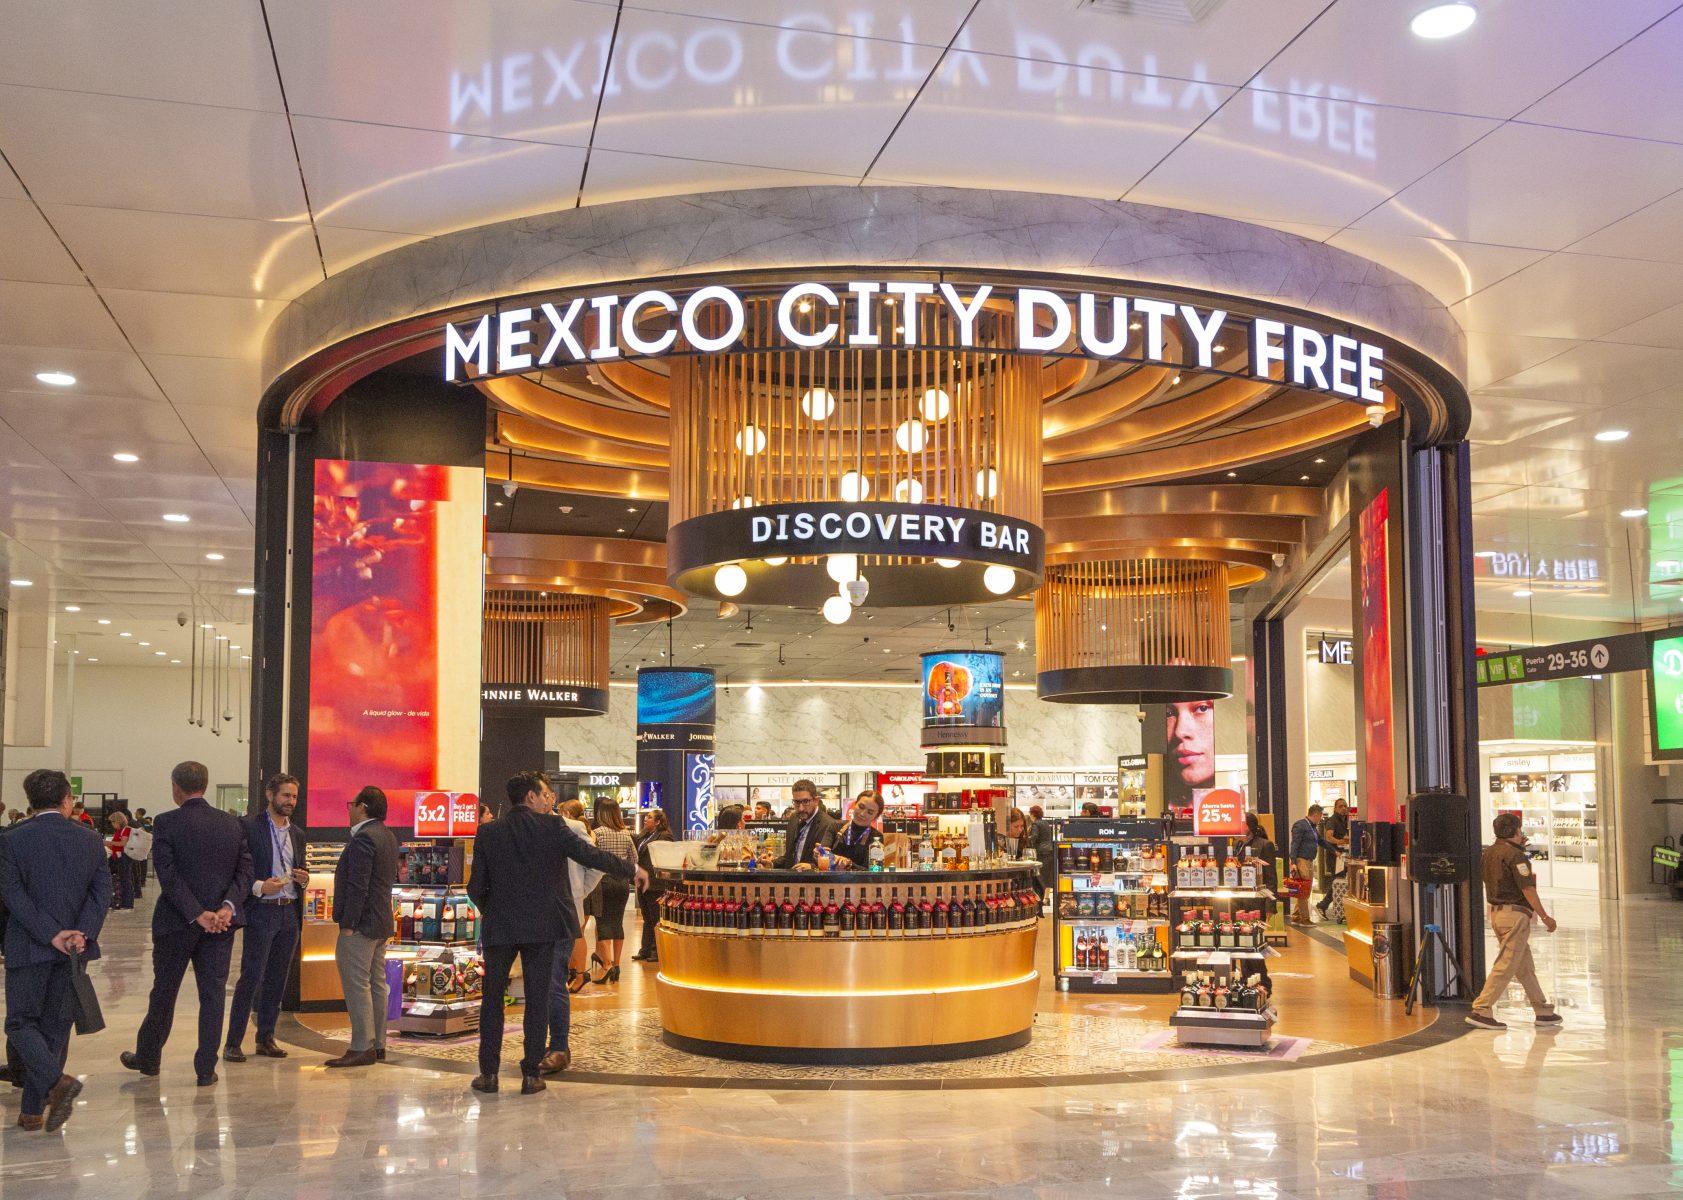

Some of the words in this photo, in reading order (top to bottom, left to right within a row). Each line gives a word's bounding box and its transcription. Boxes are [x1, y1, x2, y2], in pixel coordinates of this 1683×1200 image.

[445, 286, 745, 382] MEXICO
[777, 281, 993, 347] CITY
[1016, 288, 1227, 367] DUTY
[1254, 318, 1384, 403] FREE
[752, 511, 966, 543] DISCOVERY
[980, 521, 1030, 555] BAR
[1490, 663, 1504, 675] VIP
[1525, 656, 1545, 665] Puerta
[1546, 649, 1588, 671] 29-36
[527, 689, 578, 702] WALKER
[369, 709, 387, 717] liquid
[387, 709, 403, 718] glow
[647, 732, 675, 740] WALKER
[937, 728, 968, 738] Hennessy
[1506, 758, 1531, 767] sisley
[590, 775, 620, 785] DIOR
[1083, 775, 1101, 783] TOM
[418, 805, 446, 822] 3x2
[453, 811, 476, 822] FREE
